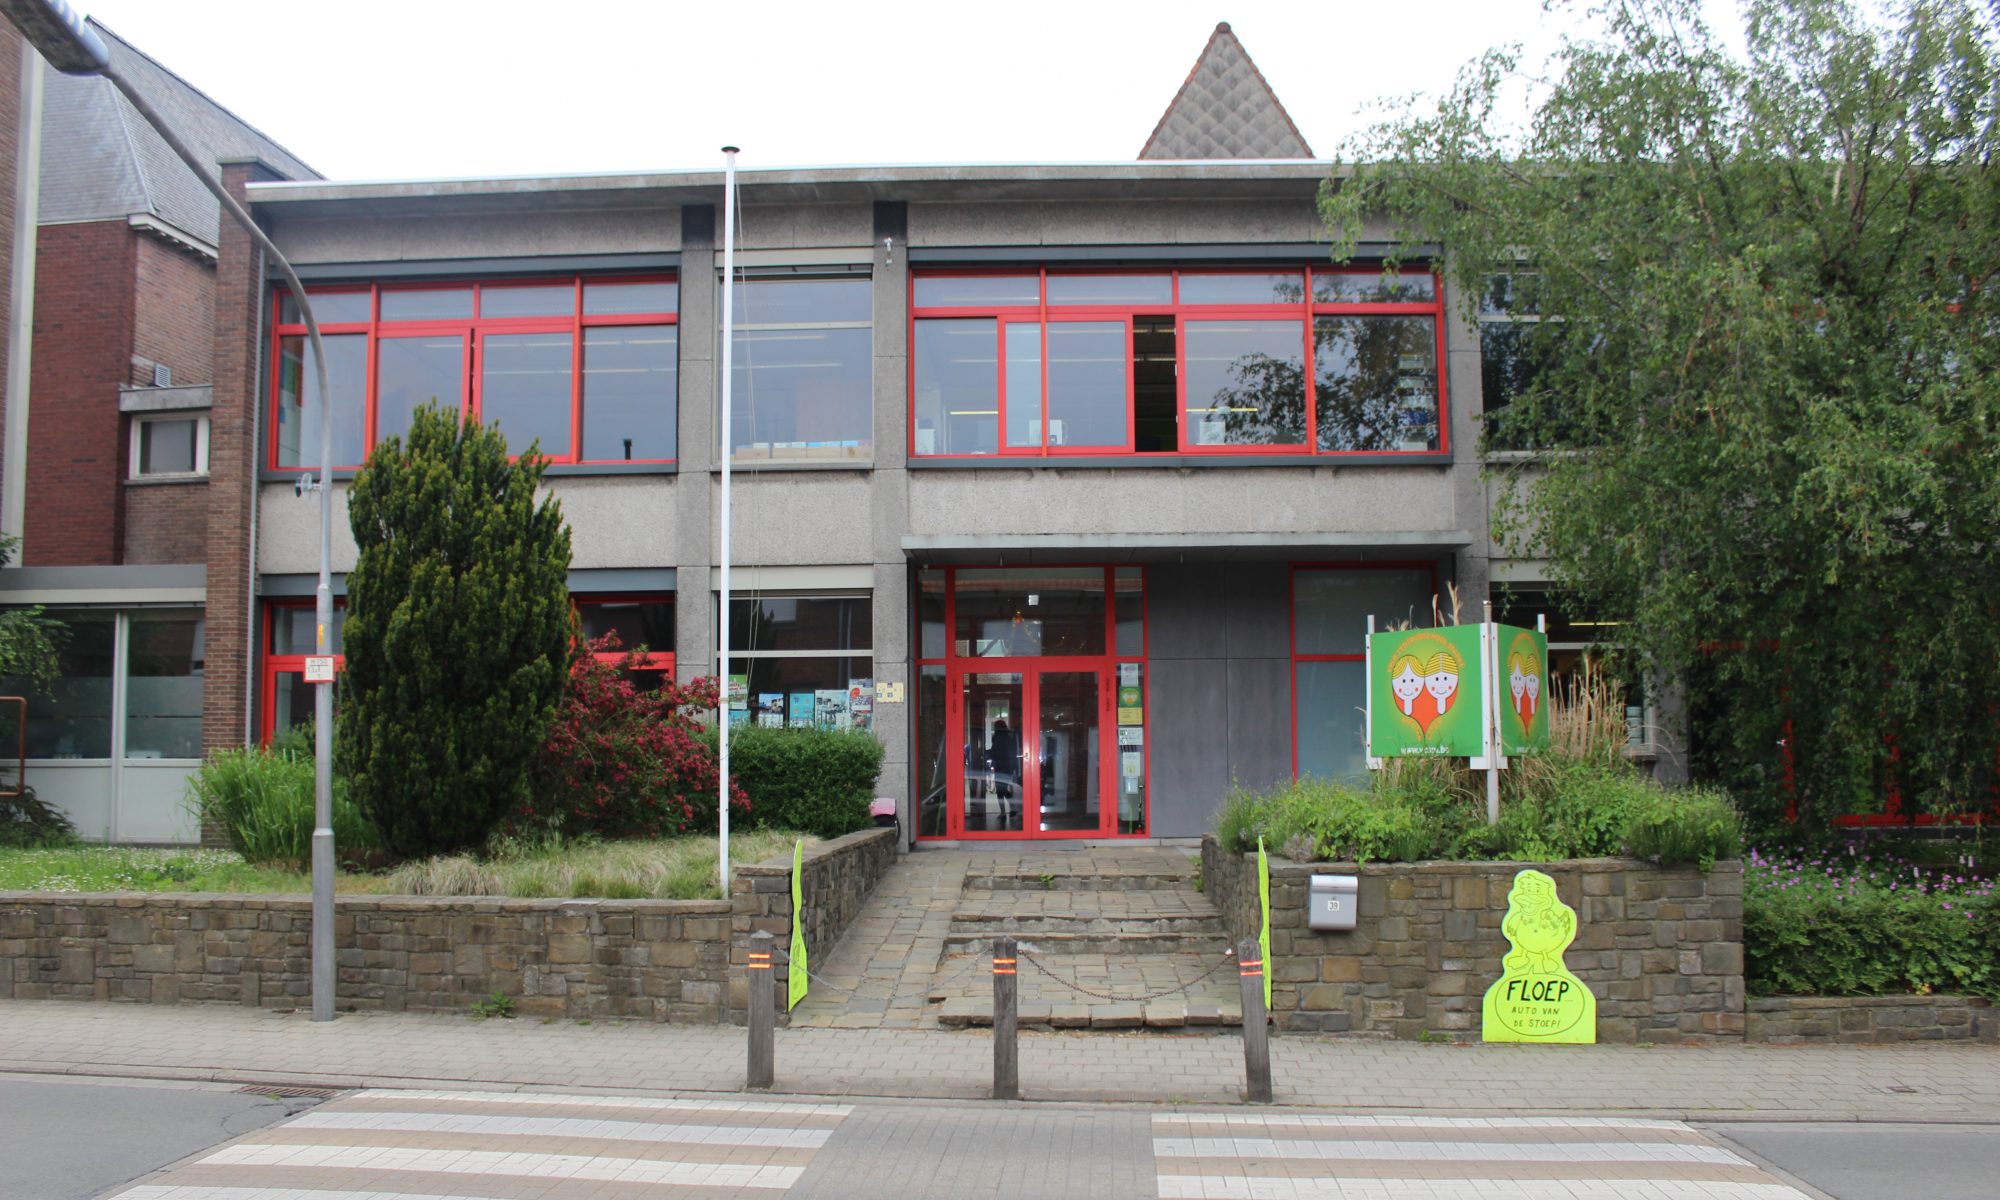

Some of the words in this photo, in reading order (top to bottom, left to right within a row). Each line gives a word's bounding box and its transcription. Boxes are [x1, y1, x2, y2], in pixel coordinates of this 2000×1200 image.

[1512, 1006, 1537, 1015] AUTO
[1543, 1007, 1560, 1015] VAN
[1528, 1019, 1561, 1028] STOEP!
